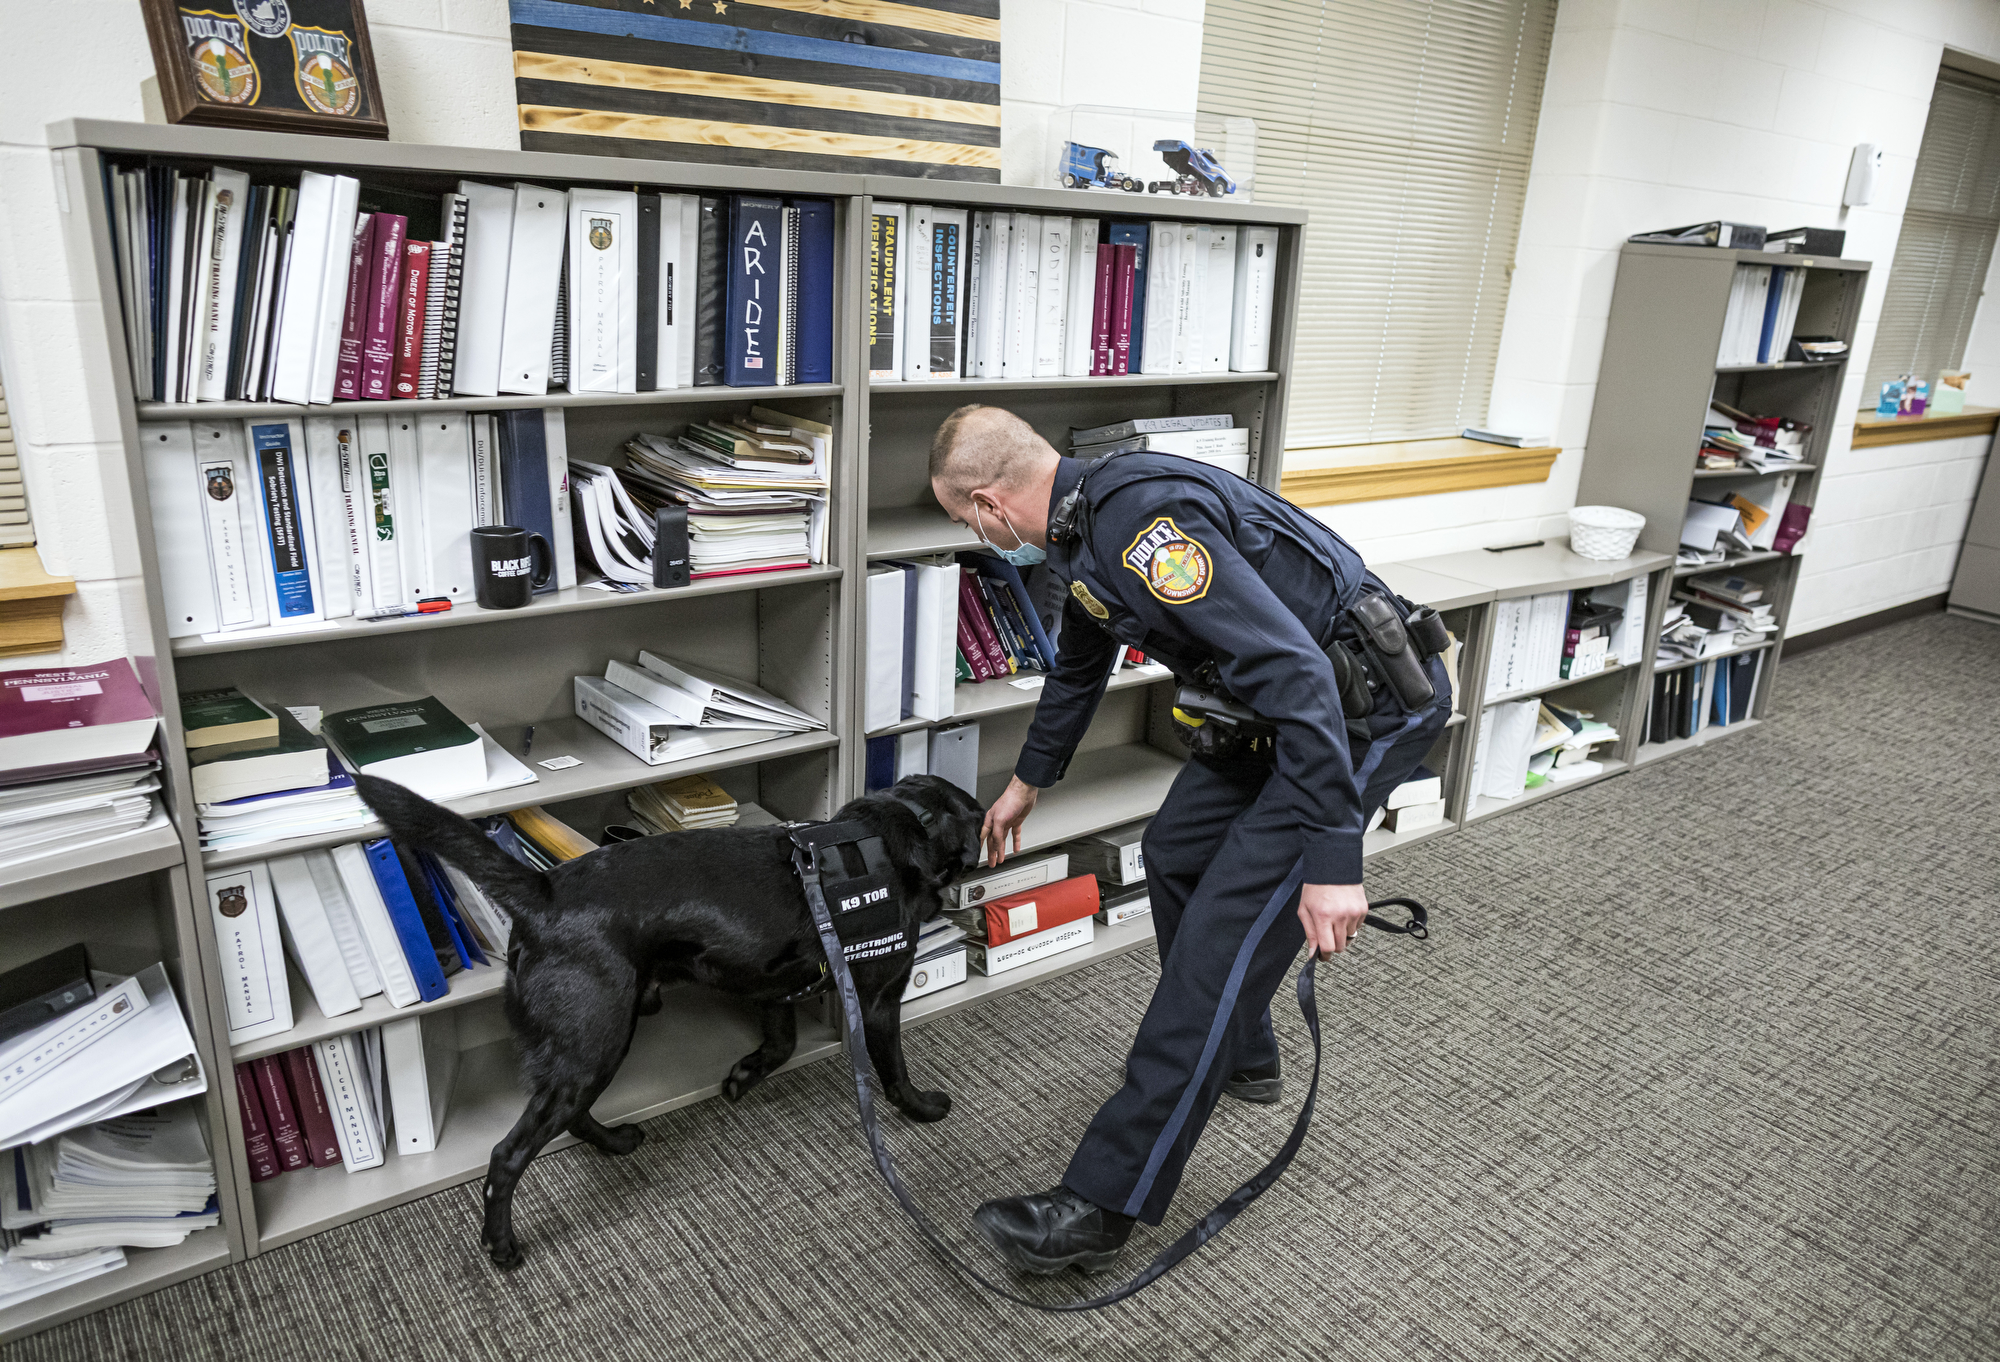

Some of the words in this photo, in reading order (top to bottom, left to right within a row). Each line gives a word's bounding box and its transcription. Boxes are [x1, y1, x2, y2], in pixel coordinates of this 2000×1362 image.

[182, 16, 246, 54] POLICE
[293, 31, 350, 68] POLICE
[238, 78, 254, 102] DERRY
[304, 85, 335, 114] TOWNSHIP
[336, 107, 345, 115] OF
[344, 91, 356, 111] DERRY
[381, 257, 389, 284] Pennsylvania
[883, 216, 895, 317] FRAUDULENT
[932, 228, 944, 325] INSPECTIONS
[946, 225, 956, 325] COUNTERFEIT
[211, 263, 221, 300] TRAINING
[409, 270, 420, 296] DIGEST
[744, 220, 767, 355] ARIDE
[869, 216, 880, 346] IDENTIFICATIONS
[408, 297, 416, 306] OF
[210, 301, 220, 332] MANUAL
[404, 307, 417, 336] MOTOR
[403, 336, 413, 358] LAWS
[1160, 418, 1187, 429] LEGAL
[1189, 417, 1222, 428] UPDATES
[274, 451, 284, 466] DWI
[268, 475, 279, 503] Sobriety
[276, 465, 288, 496] Detection
[271, 502, 282, 526] Testing
[281, 496, 291, 510] and
[345, 494, 356, 526] TRAINING
[276, 526, 286, 546] (SFST)
[283, 510, 297, 551] Standardized
[350, 528, 359, 555] MANUAL
[222, 519, 231, 558] PATROL
[227, 564, 237, 602] MANUAL
[289, 551, 299, 568] Field
[1127, 522, 1183, 576] POLICE
[491, 560, 520, 572] BLACK
[497, 570, 517, 578] COFFEE
[1195, 555, 1206, 576] DERRY
[1163, 585, 1197, 597] TOWNSHIP
[1197, 576, 1204, 586] OF
[4, 672, 110, 686] PENNSYLVANIA
[37, 684, 84, 692] CRIMINAL
[345, 706, 426, 723] PENNSYLVANIA
[841, 897, 860, 911] K9
[863, 888, 888, 904] TOR
[843, 932, 903, 954] ELECTRONIC
[843, 947, 892, 962] ETECTION
[894, 940, 908, 951] K9
[235, 931, 245, 969] PATROL
[241, 976, 252, 1014] MANUAL
[33, 1013, 108, 1063] OFFICER
[329, 1044, 349, 1100] OFFICER
[346, 1106, 364, 1153] MANUAL
